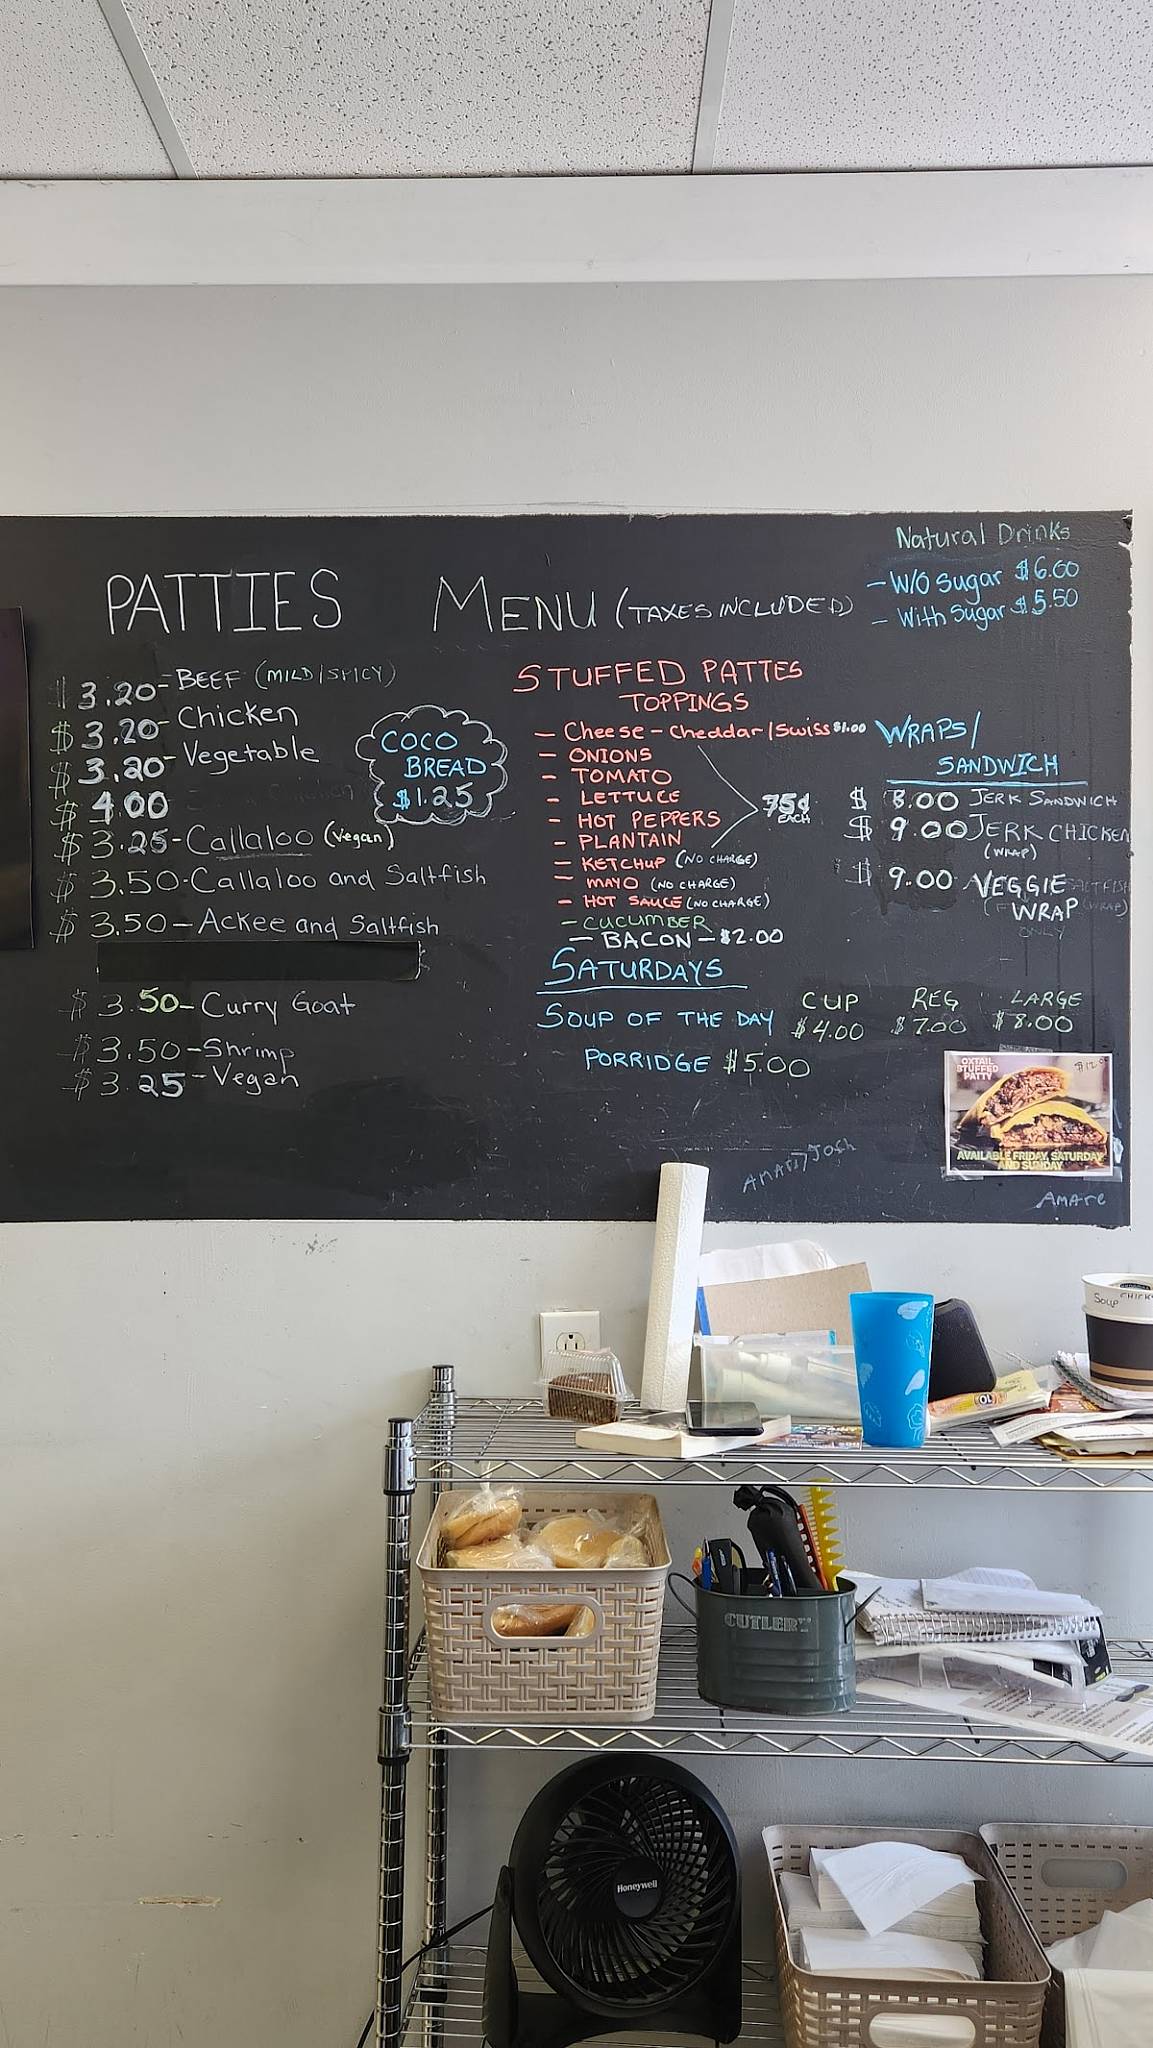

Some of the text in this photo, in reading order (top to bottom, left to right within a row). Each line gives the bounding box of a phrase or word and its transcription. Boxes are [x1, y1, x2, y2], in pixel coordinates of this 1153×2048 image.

[895, 520, 1071, 550] Natural Drinks
[890, 568, 931, 595] W/O
[935, 568, 1003, 605] Sugar
[106, 568, 343, 635] PATTIES
[432, 575, 598, 633] MENU
[897, 588, 1079, 631] With Sugar $5.50
[175, 668, 241, 691] BEEF
[512, 658, 687, 693] STUFFED
[618, 691, 750, 713] TOPPINGS
[177, 700, 299, 730] Chicken
[381, 730, 458, 753] COCO
[563, 720, 645, 742] Cheese
[832, 720, 867, 734] $1.00
[182, 735, 321, 776] Vegetable
[403, 755, 487, 779] BREAD
[568, 747, 653, 764] ONIONS
[936, 752, 1060, 779] SANDWICH
[570, 766, 673, 786] TOMATO
[392, 781, 474, 811] $1.25
[580, 789, 681, 805] LETTUCE
[968, 787, 1022, 808] JERK
[1028, 789, 1119, 808] SANDWICH
[578, 809, 722, 831] HOT PEPPERS
[776, 812, 812, 825] EACH
[965, 812, 1044, 843] JERK
[1048, 822, 1132, 844] CHICKEN
[186, 824, 314, 857] Callaloo
[578, 829, 683, 851] PLANTAIN
[580, 856, 666, 871] KETCHUP
[190, 866, 318, 894] Callaloo
[328, 868, 376, 890] and
[384, 862, 487, 887] Saltfish
[585, 875, 640, 890] MAYO
[973, 869, 1067, 900] VEGGIE
[583, 894, 617, 909] HOT
[628, 894, 683, 910] SAUCE
[1011, 897, 1079, 922] WRAP
[197, 906, 286, 937] Ackee
[295, 916, 338, 940] and
[349, 913, 441, 937] Saltfish
[582, 914, 713, 933] CUCUMBER
[600, 928, 785, 950] BACON $2.00
[544, 947, 723, 986] SATURDAYS
[201, 991, 279, 1025] Curry
[292, 990, 357, 1016] Goat
[801, 992, 860, 1011] CUP
[911, 986, 960, 1011] REG
[1010, 990, 1084, 1008] LARGE
[626, 1011, 664, 1027] OF
[676, 1010, 724, 1027] THE
[735, 1009, 776, 1037] DAY
[790, 1016, 866, 1043] $4.00
[992, 1011, 1074, 1033] $8.00
[203, 1032, 296, 1073] Shrimp
[583, 1048, 812, 1078] PORRIDGE $5.00
[961, 1057, 995, 1065] OXTAIL
[211, 1062, 300, 1096] Vegan
[956, 1064, 999, 1073] STUFFED
[963, 1071, 993, 1081] PATTY
[956, 1150, 1011, 1161] AVAILABLE
[1050, 1151, 1105, 1162] SATURDAY
[997, 1160, 1064, 1171] AND SUNDAY
[1119, 1292, 1153, 1301] CHICK
[617, 1879, 658, 1894] Honeywell
